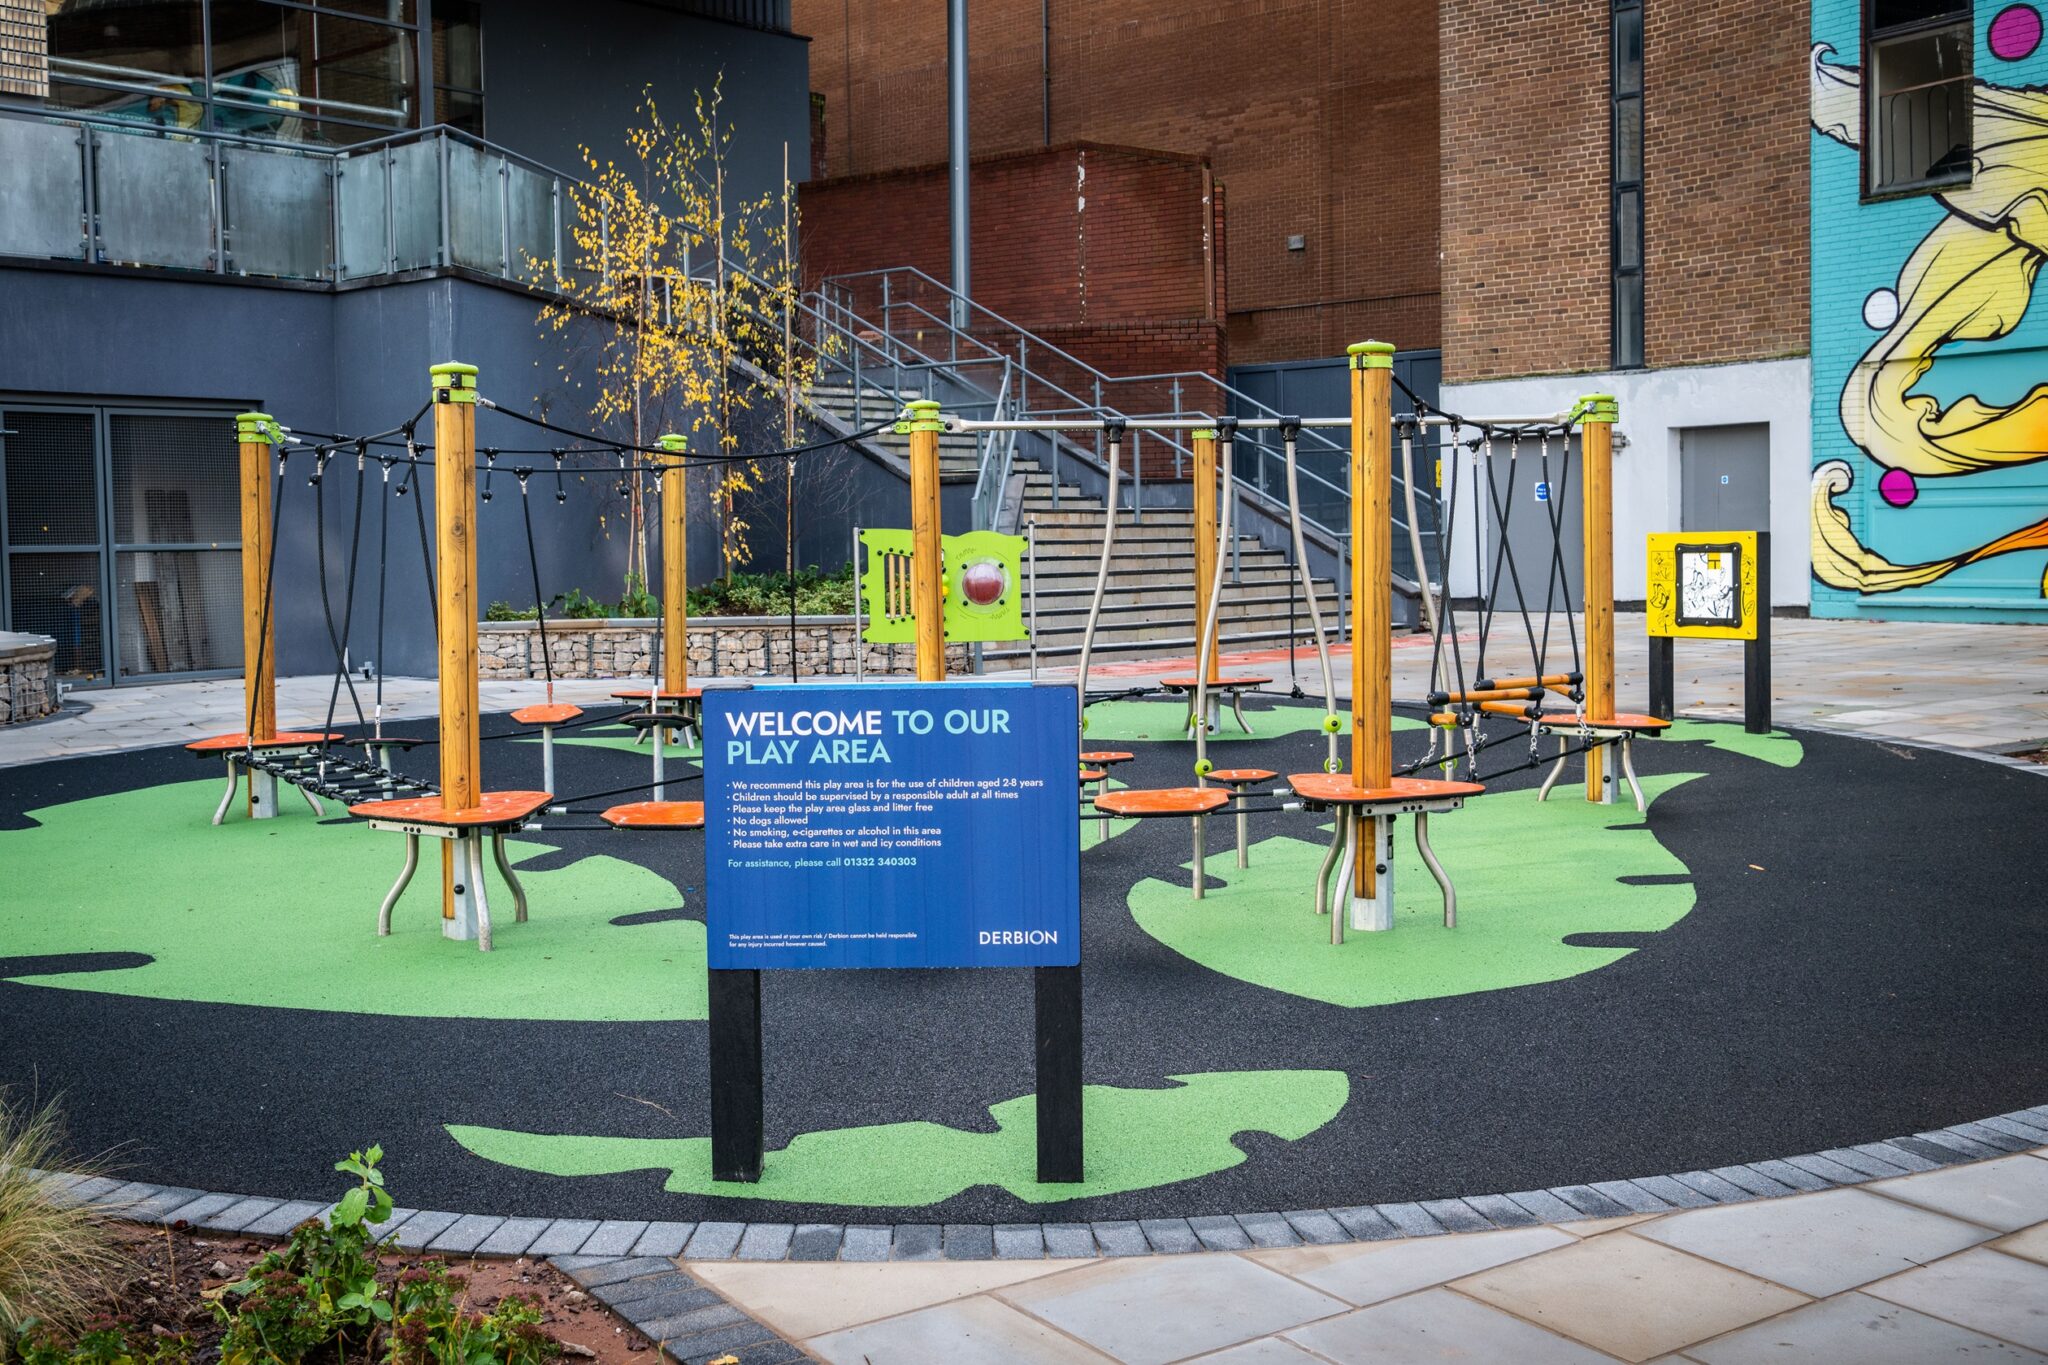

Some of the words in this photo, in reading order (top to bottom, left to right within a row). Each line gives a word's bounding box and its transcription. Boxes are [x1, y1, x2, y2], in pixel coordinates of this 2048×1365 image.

[725, 710, 882, 737] WELCOME
[892, 710, 933, 735] TO
[944, 709, 1010, 734] OUR
[727, 739, 800, 765] PLAY
[808, 738, 891, 764] AREA
[732, 781, 747, 790] We
[750, 780, 802, 790] recommend
[805, 780, 821, 789] this
[823, 779, 842, 791] play
[866, 780, 874, 789] is
[876, 778, 889, 788] for
[891, 779, 906, 788] the
[926, 778, 936, 788] of
[938, 778, 974, 788] children
[977, 777, 1000, 790] aged
[1002, 778, 1017, 787] 2-8
[1019, 780, 1043, 789] years
[732, 792, 770, 802] Children
[773, 791, 803, 801] should
[805, 791, 817, 801] be
[820, 791, 868, 802] supervised
[870, 790, 881, 802] by
[892, 790, 944, 802] responsible
[946, 790, 968, 800] adult
[981, 789, 992, 799] all
[994, 790, 1018, 799] times
[733, 804, 761, 813] Please
[764, 804, 786, 815] keep
[788, 803, 802, 813] the
[805, 803, 824, 815] play
[848, 802, 871, 814] glass
[873, 802, 890, 812] and
[892, 802, 912, 812] litter
[915, 802, 933, 812] free
[733, 816, 747, 825] No
[749, 815, 772, 827] dogs
[773, 815, 808, 825] allowed
[733, 828, 747, 837] No
[750, 827, 789, 839] smoking,
[792, 827, 843, 838] e-cigarettes
[858, 826, 890, 836] alcohol
[892, 826, 901, 835] in
[903, 825, 919, 835] this
[733, 839, 762, 848] Please
[764, 838, 783, 848] take
[832, 839, 840, 848] in
[843, 839, 858, 848] wet
[861, 837, 878, 848] and
[880, 838, 893, 849] icy
[895, 837, 942, 847] conditions
[728, 859, 742, 868] For
[745, 858, 791, 869] assistance,
[794, 857, 823, 869] please
[826, 857, 841, 867] call
[843, 857, 875, 866] 01332
[877, 857, 917, 866] 340303
[979, 930, 1057, 945] DERBION
